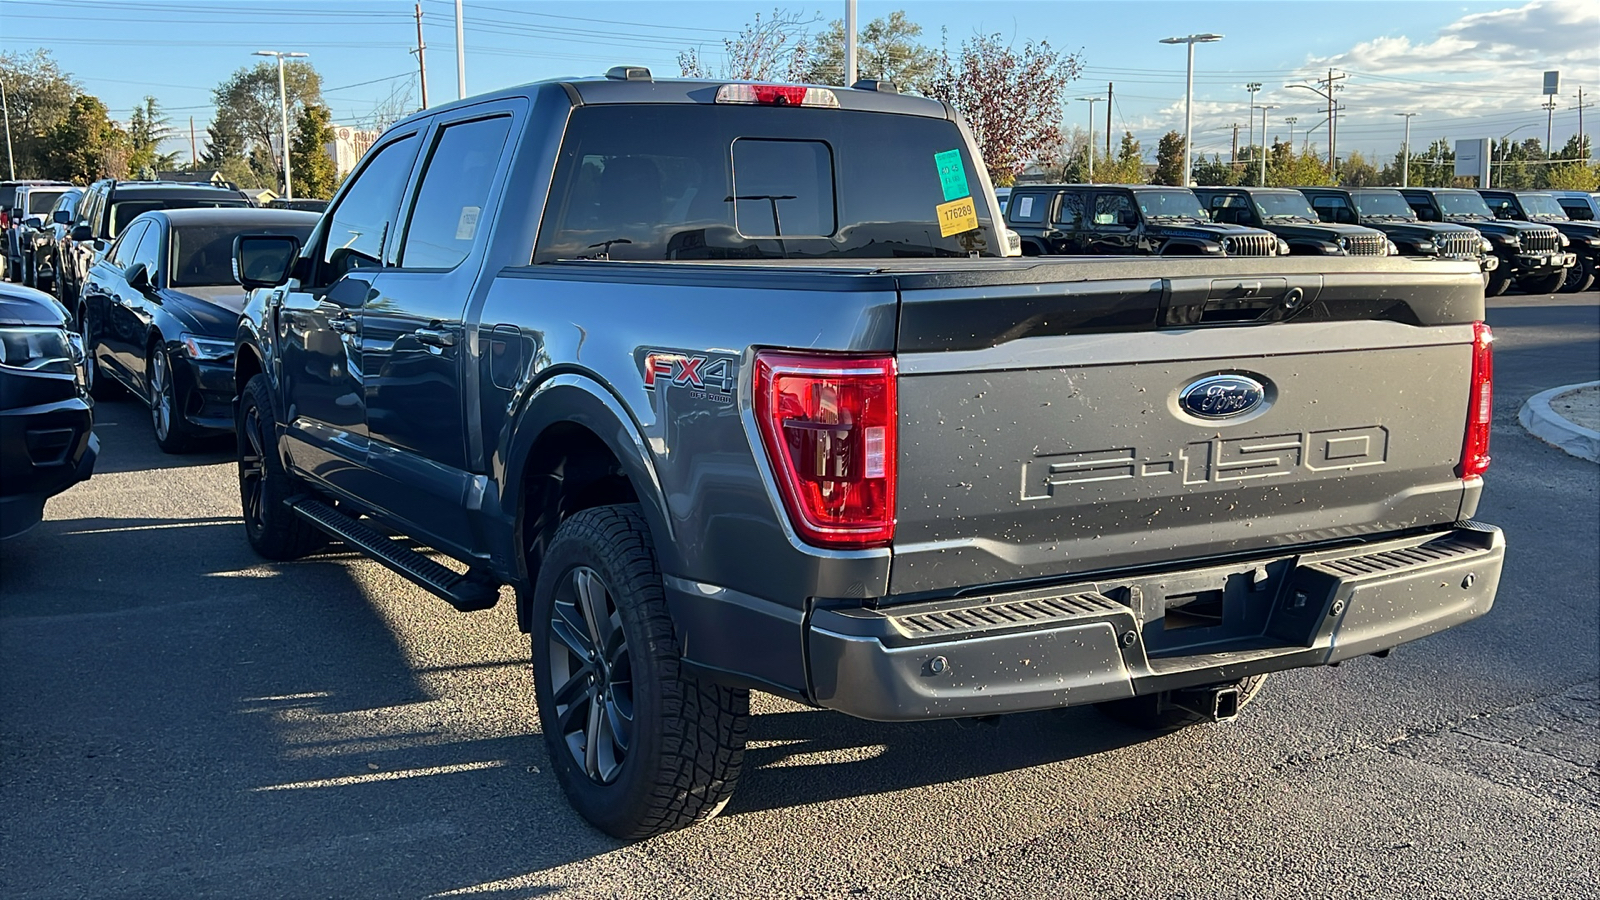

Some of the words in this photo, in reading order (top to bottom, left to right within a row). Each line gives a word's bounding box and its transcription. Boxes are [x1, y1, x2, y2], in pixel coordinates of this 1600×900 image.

[944, 204, 972, 221] 176289
[643, 350, 734, 395] FX4
[690, 391, 707, 400] OFF
[708, 393, 732, 404] ROAD
[1202, 385, 1248, 410] Ford
[1021, 425, 1389, 501] F-150
